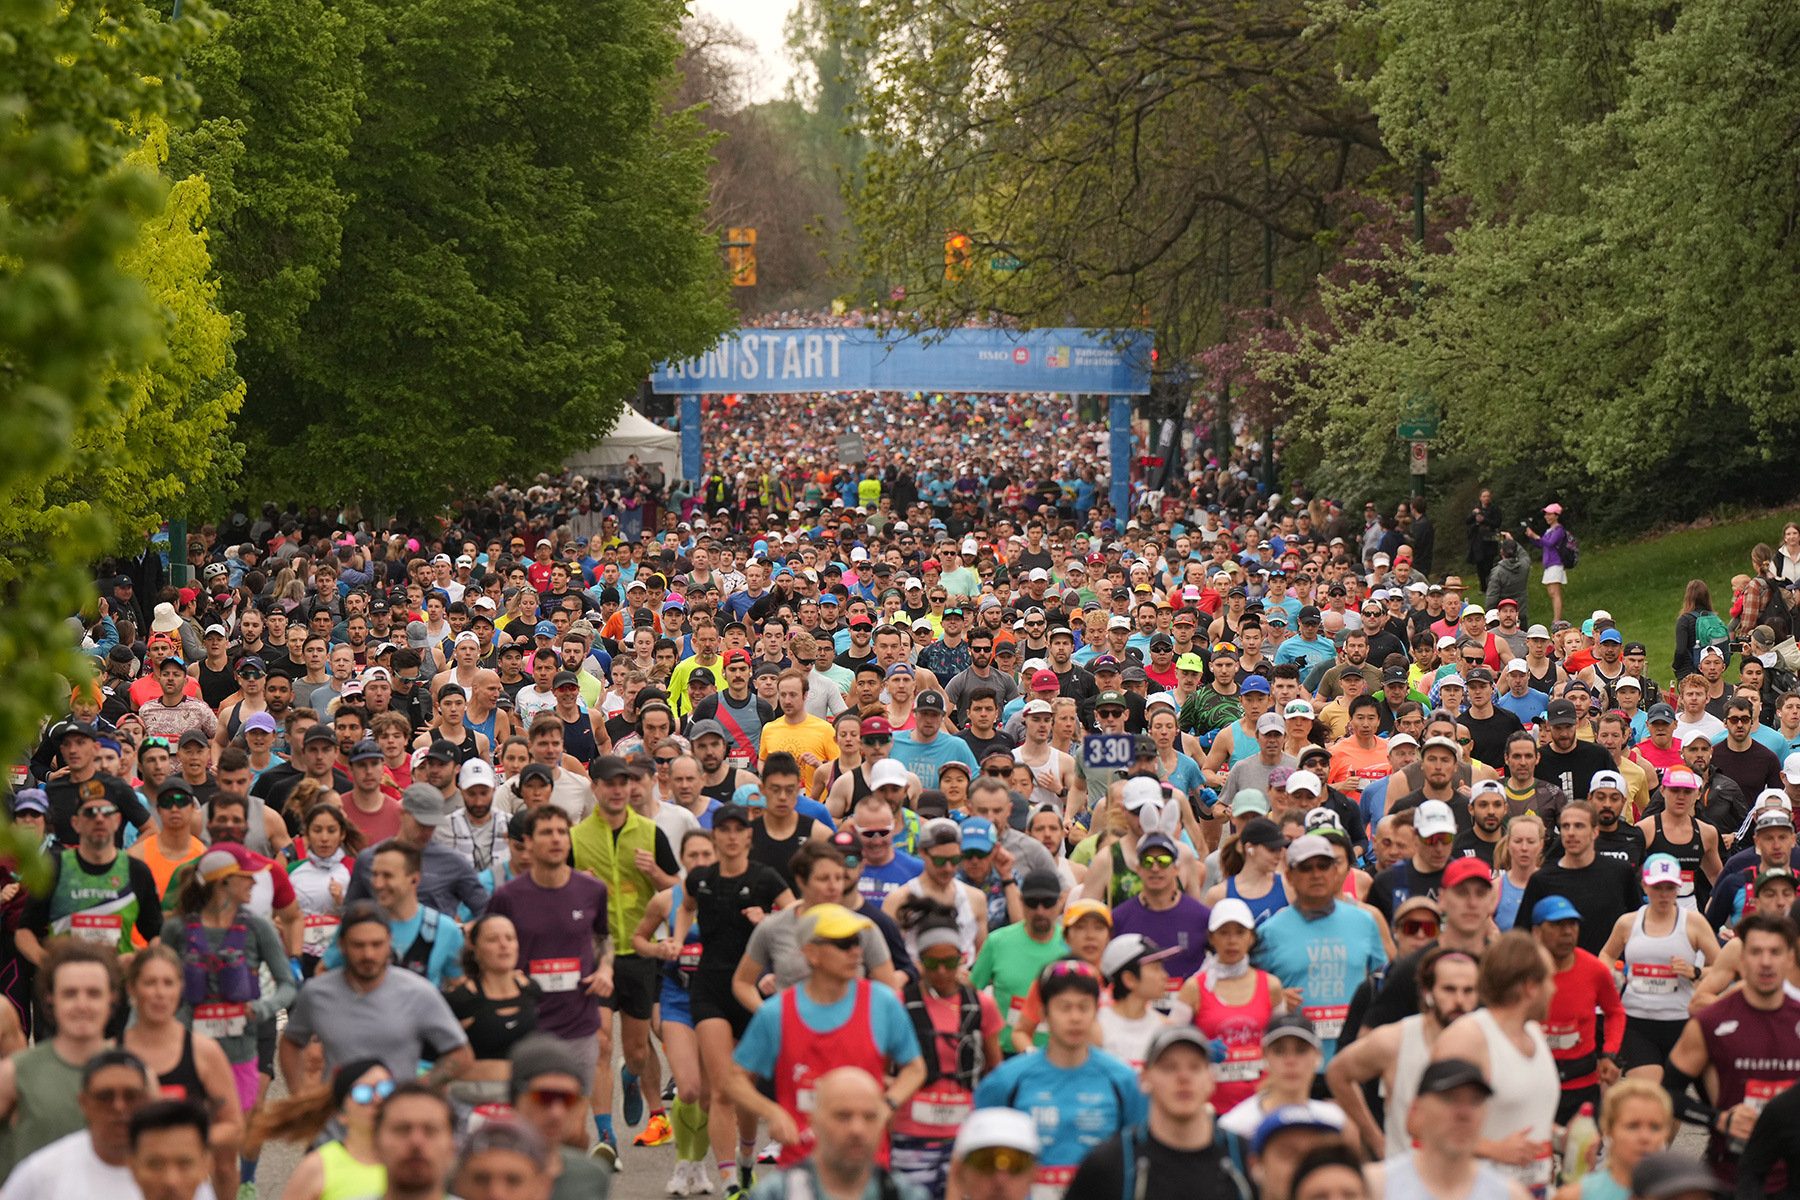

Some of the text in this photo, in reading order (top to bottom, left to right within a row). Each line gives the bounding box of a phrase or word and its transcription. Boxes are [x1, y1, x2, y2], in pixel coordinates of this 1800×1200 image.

[740, 334, 845, 380] START
[978, 350, 1009, 361] BMO
[1074, 357, 1121, 367] Marathon
[1089, 738, 1131, 764] 3:30
[908, 762, 936, 776] VAN
[71, 888, 119, 900] LIETUVA
[1306, 944, 1347, 963] VAN
[1308, 962, 1347, 981] COU
[1308, 980, 1345, 999] VER
